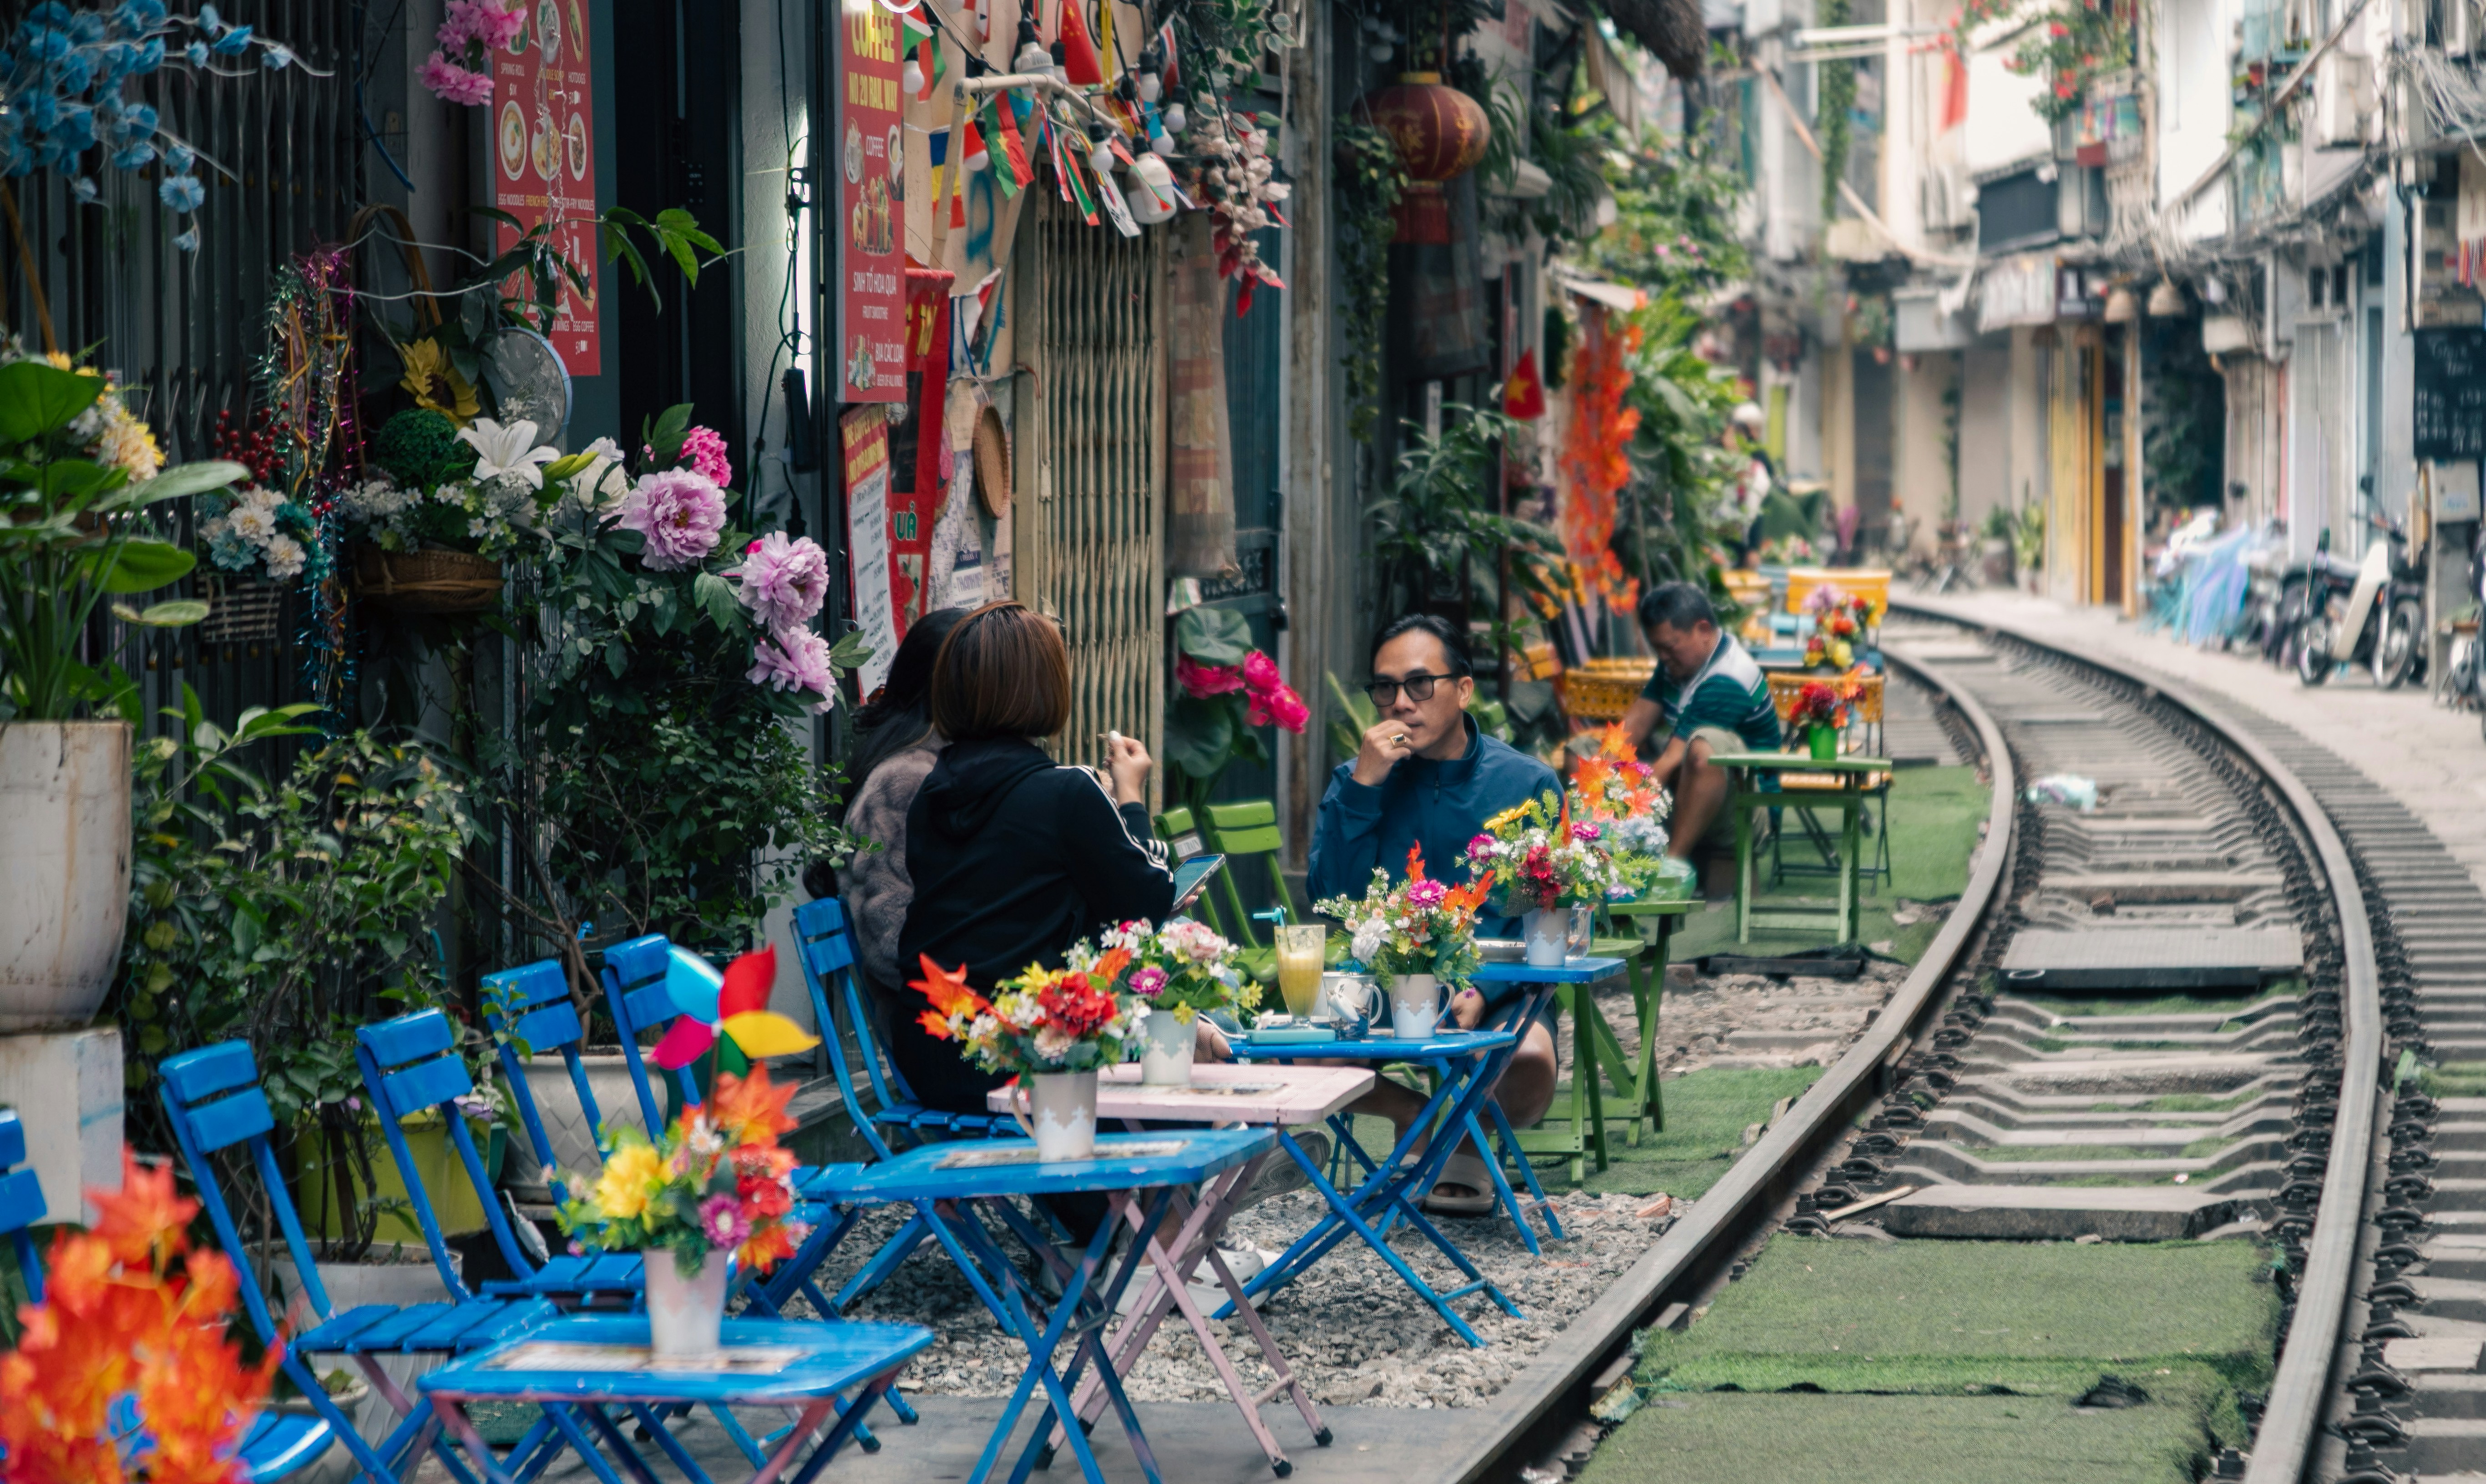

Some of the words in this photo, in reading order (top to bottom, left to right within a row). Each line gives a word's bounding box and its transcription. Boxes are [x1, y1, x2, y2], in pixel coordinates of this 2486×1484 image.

[851, 1, 895, 63] COFFEE
[501, 62, 515, 76] SPRING
[515, 64, 524, 76] ROLL
[568, 71, 586, 85] HOTDOGS
[849, 71, 859, 105] NO
[860, 74, 868, 107] 20
[869, 75, 883, 110] RAIL
[884, 79, 898, 112] WAY
[866, 135, 884, 158] COFFEE
[506, 194, 525, 206] NOODLES
[526, 195, 540, 207] FRENCH
[577, 199, 594, 211] NOODLES
[853, 272, 866, 292] SINH
[874, 274, 885, 294] HOA
[573, 321, 581, 332] EGG
[581, 321, 594, 333] COFFEE
[893, 501, 917, 541] UẢ
